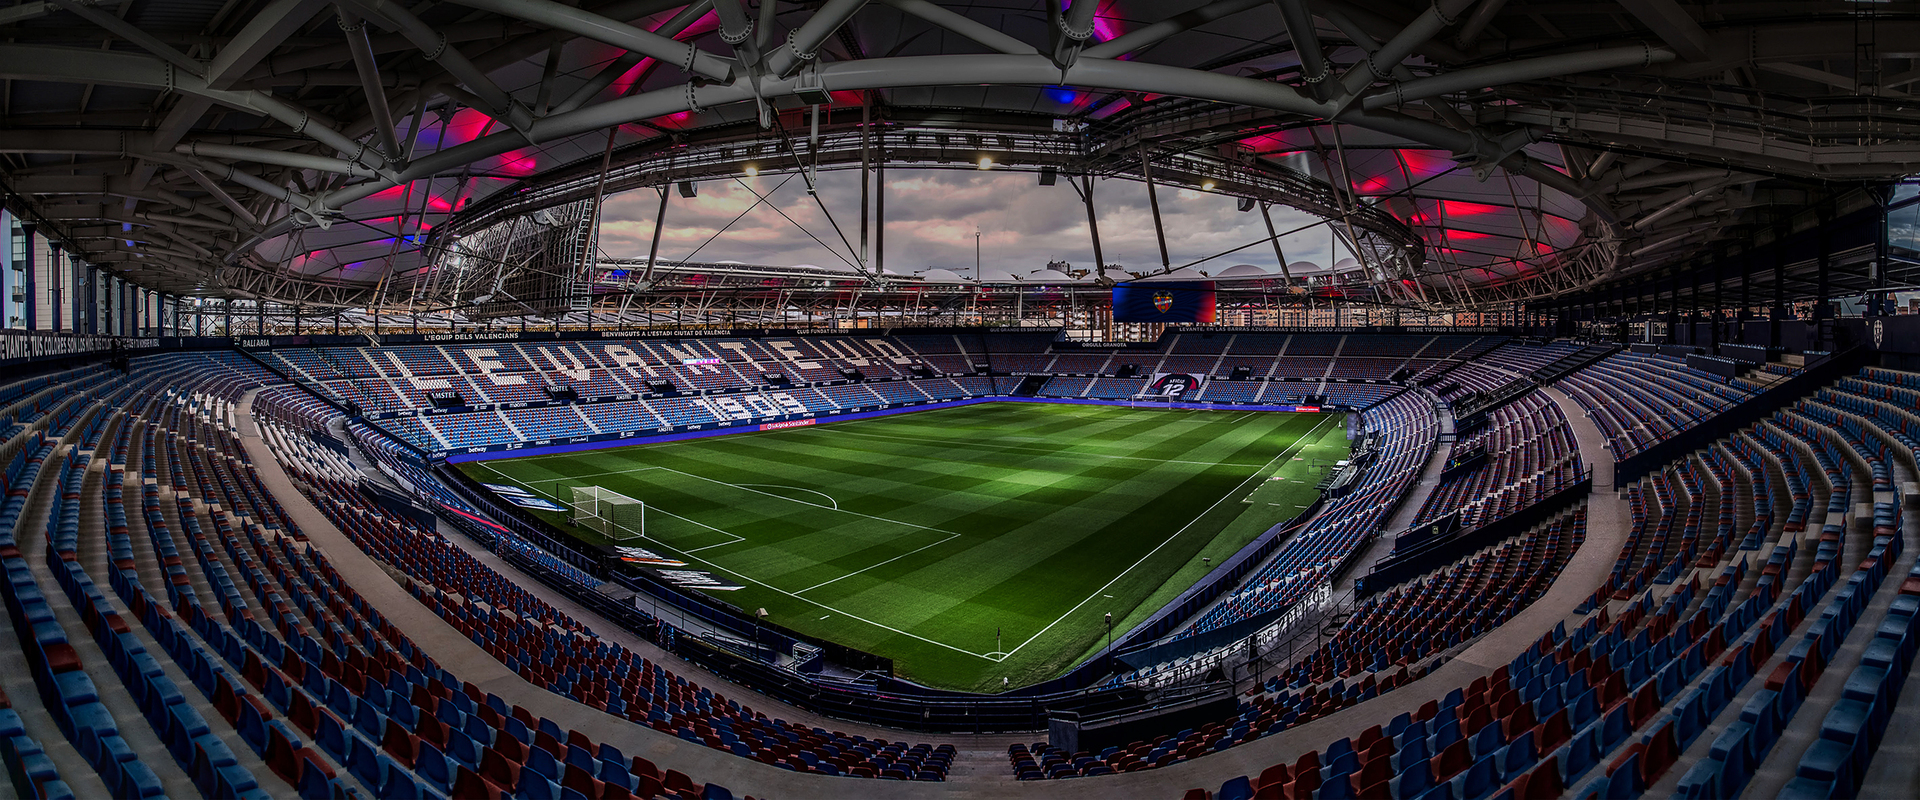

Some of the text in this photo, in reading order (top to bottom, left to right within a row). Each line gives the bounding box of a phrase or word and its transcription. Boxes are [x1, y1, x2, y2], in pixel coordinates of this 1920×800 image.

[31, 336, 44, 357] TUS
[44, 336, 66, 356] COLORES
[67, 337, 78, 354] SON
[1163, 383, 1185, 396] 12
